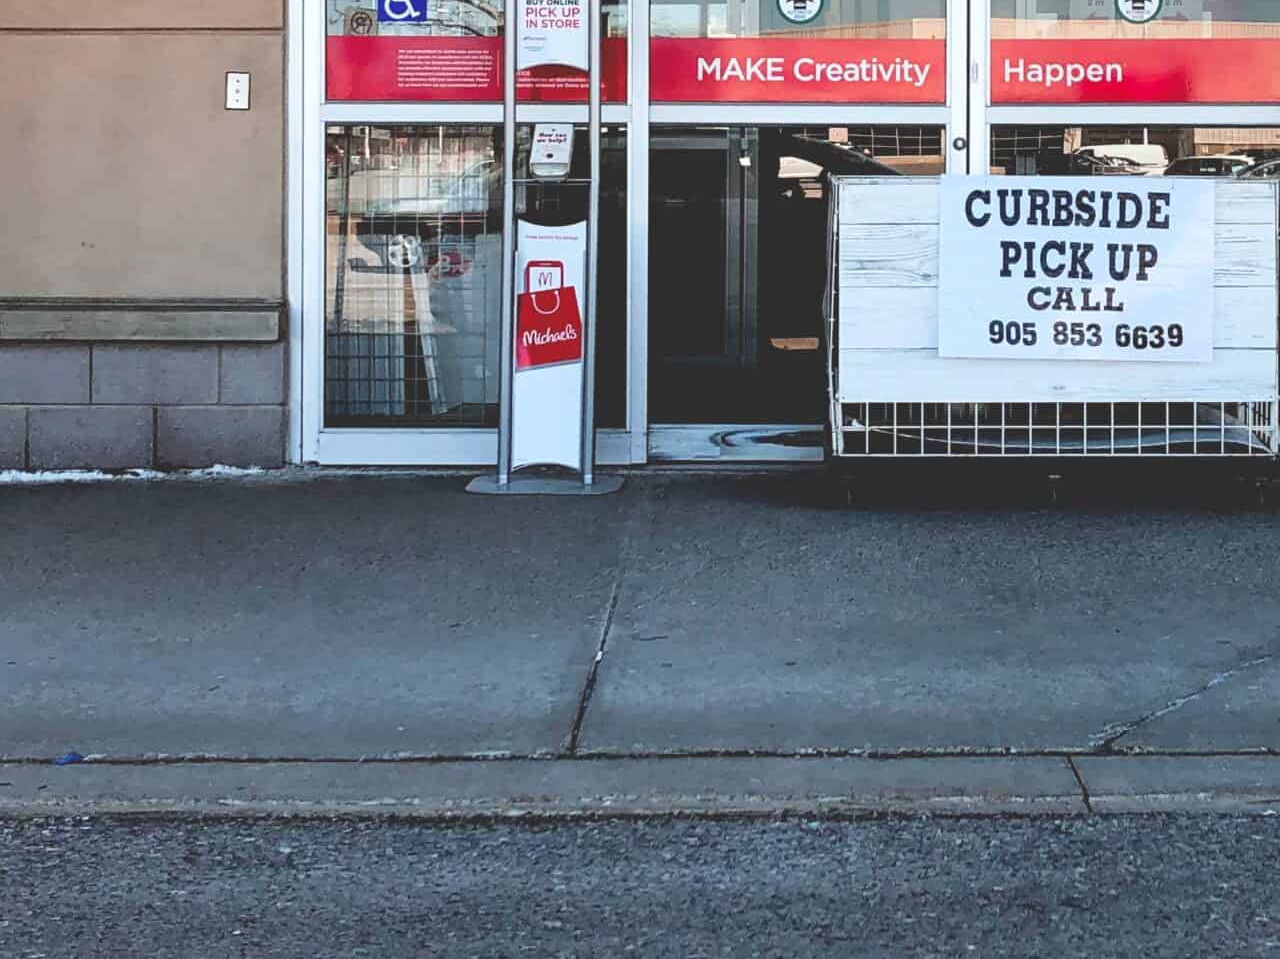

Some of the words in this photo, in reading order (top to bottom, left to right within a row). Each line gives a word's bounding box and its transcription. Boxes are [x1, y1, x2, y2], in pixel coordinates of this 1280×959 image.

[526, 7, 557, 18] PICK
[561, 7, 580, 18] UP
[526, 18, 538, 29] IN
[541, 18, 581, 29] STORE
[696, 57, 785, 82] MAKE
[793, 57, 931, 87] Creativity
[1003, 58, 1123, 88] Happen
[965, 189, 1171, 229] CURBSIDE
[1000, 240, 1094, 280] PICK
[1106, 243, 1158, 281] UP
[1027, 286, 1124, 312] CALL
[522, 323, 577, 346] Michaels
[989, 320, 1037, 346] 905
[1053, 321, 1102, 346] 853
[1115, 324, 1184, 349] 6639
